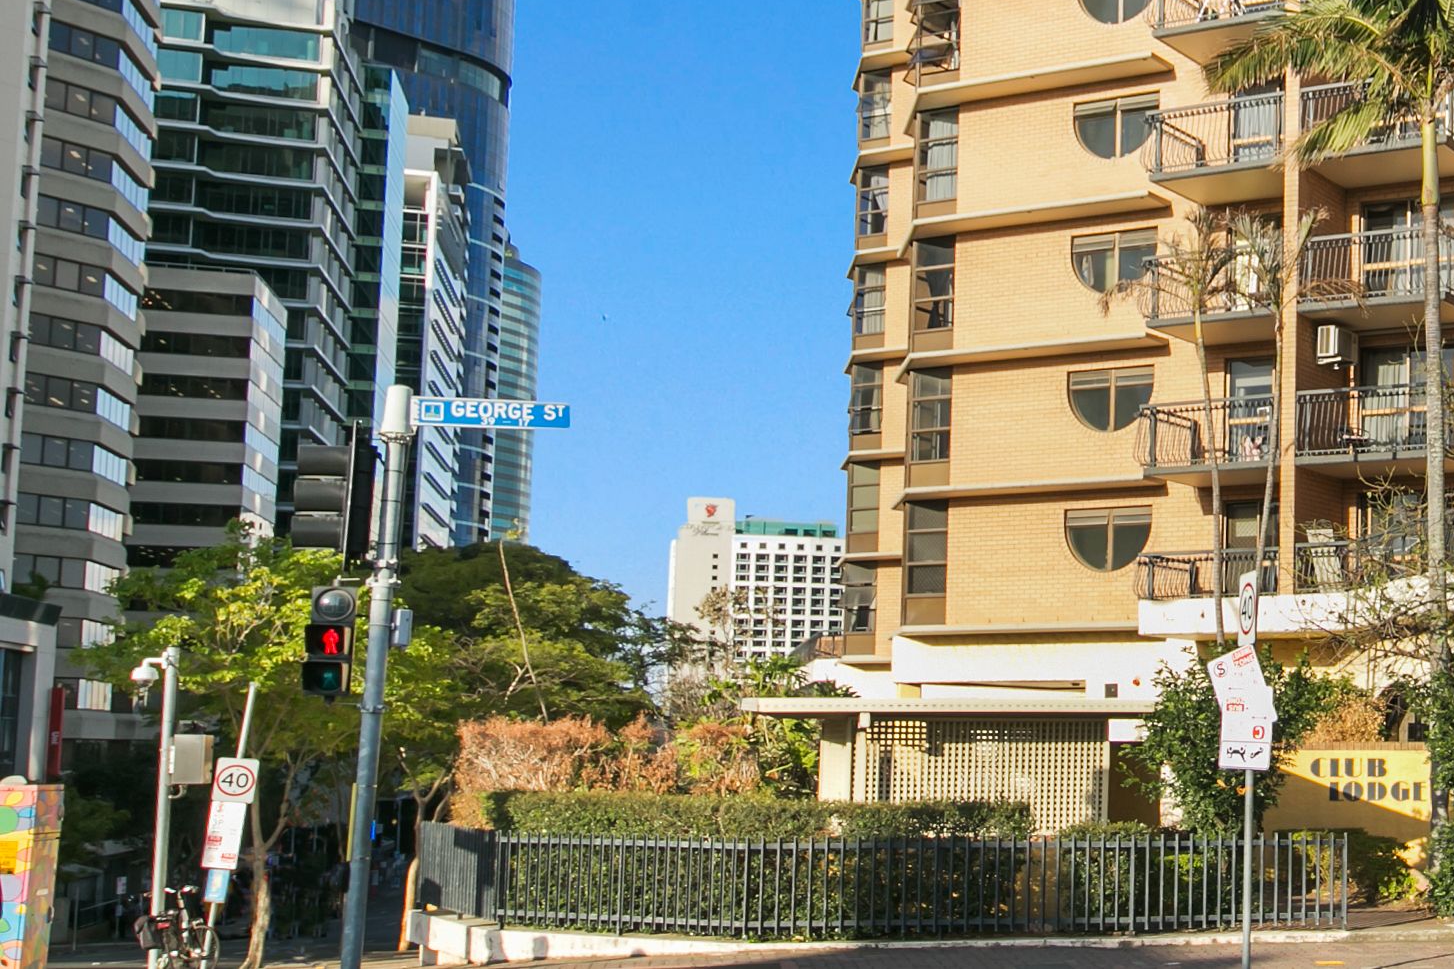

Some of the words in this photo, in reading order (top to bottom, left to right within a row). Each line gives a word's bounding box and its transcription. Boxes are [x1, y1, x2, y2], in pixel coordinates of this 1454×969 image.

[451, 401, 534, 420] GEORGE
[543, 404, 565, 421] ST
[481, 417, 495, 426] 39
[518, 418, 530, 427] 17
[1241, 595, 1253, 620] 40
[1310, 757, 1388, 778] CLUB
[221, 772, 249, 788] 40
[1329, 781, 1427, 802] LODGE
